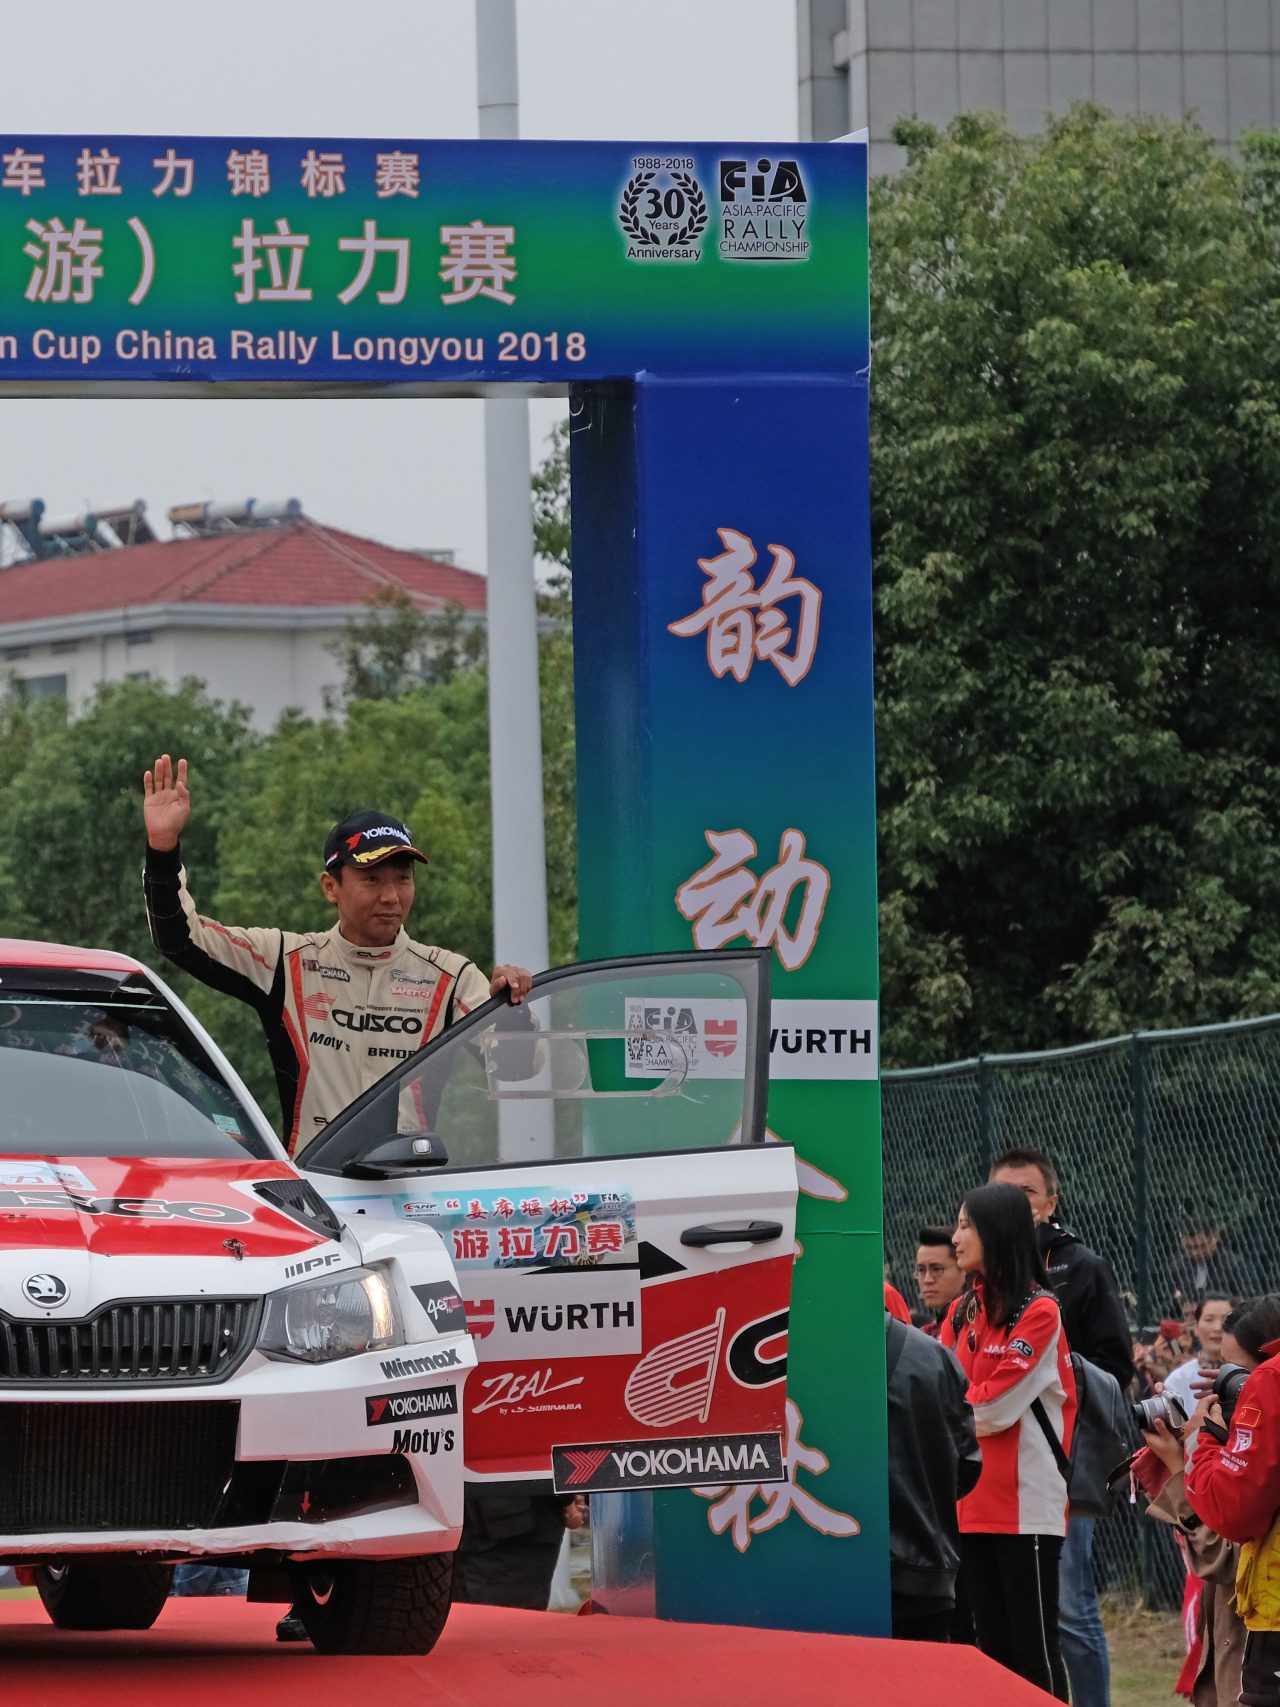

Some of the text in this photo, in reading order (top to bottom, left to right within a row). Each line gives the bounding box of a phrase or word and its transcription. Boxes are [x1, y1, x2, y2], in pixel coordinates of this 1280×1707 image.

[632, 158, 694, 169] 1988-2018
[644, 188, 685, 219] 30
[722, 204, 806, 217] ASIA-PACIFIC
[648, 220, 680, 230] Years
[724, 219, 806, 239] RALLY
[627, 246, 701, 261] Anniversary
[719, 241, 810, 253] CHAMPIONSHIP
[32, 328, 101, 363] Cup
[115, 329, 216, 360] China
[230, 330, 318, 364] Rally
[332, 330, 484, 365] Longyou
[497, 331, 586, 362] 2018
[331, 1008, 423, 1034] CUSCO
[440, 1223, 622, 1260] 游拉力赛
[505, 1301, 635, 1333] WÜRTH
[472, 1367, 584, 1414] ZEAL
[389, 1391, 454, 1417] YOKOHAMA
[391, 1428, 455, 1456] Moty's
[612, 1443, 770, 1480] YOKOHAMA
